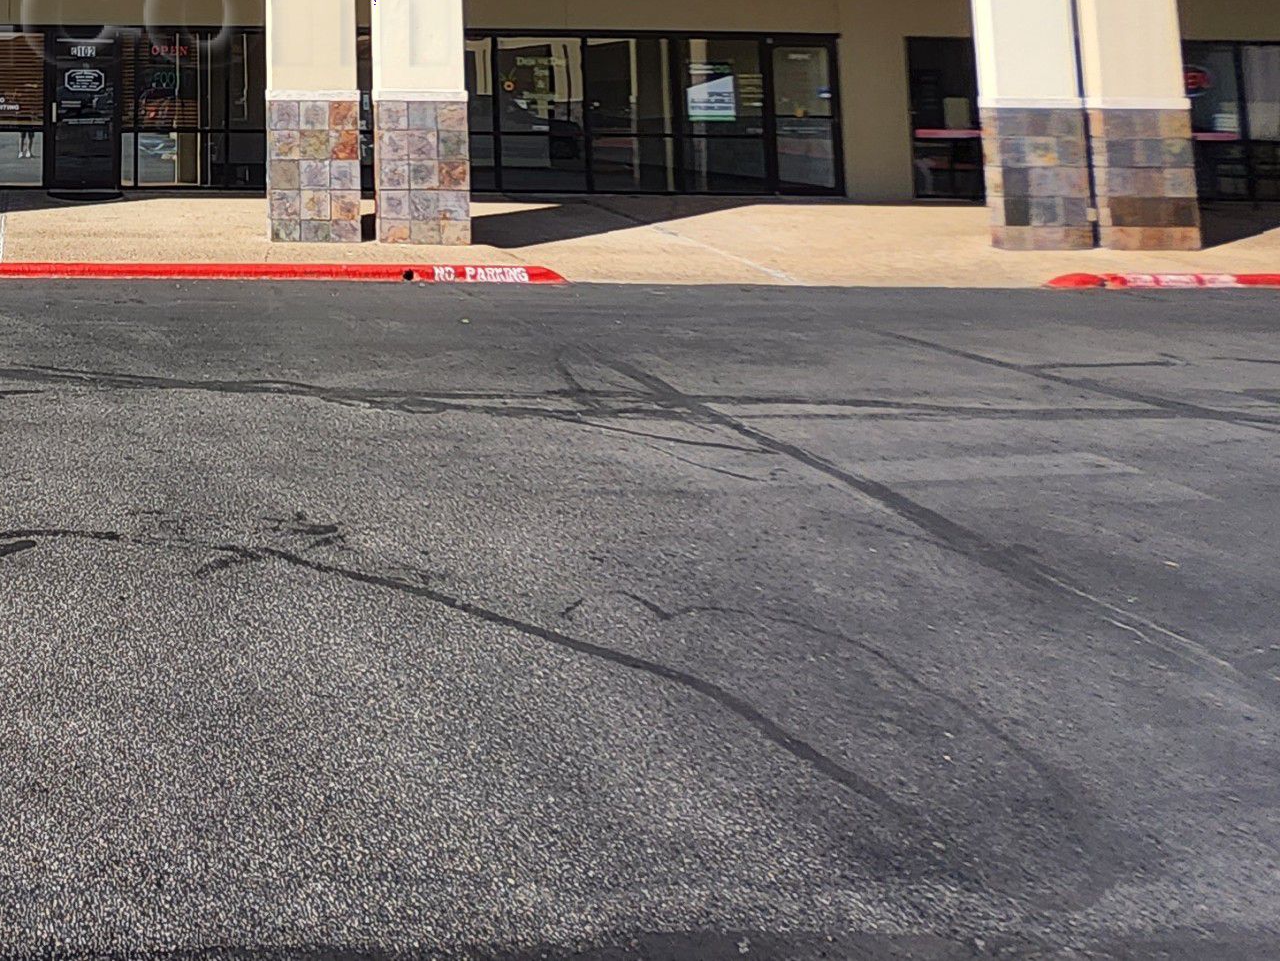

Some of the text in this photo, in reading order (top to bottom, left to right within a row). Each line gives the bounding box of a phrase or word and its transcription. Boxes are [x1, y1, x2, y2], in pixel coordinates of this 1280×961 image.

[151, 45, 188, 56] OPEN
[434, 266, 530, 283] NO PARKING
